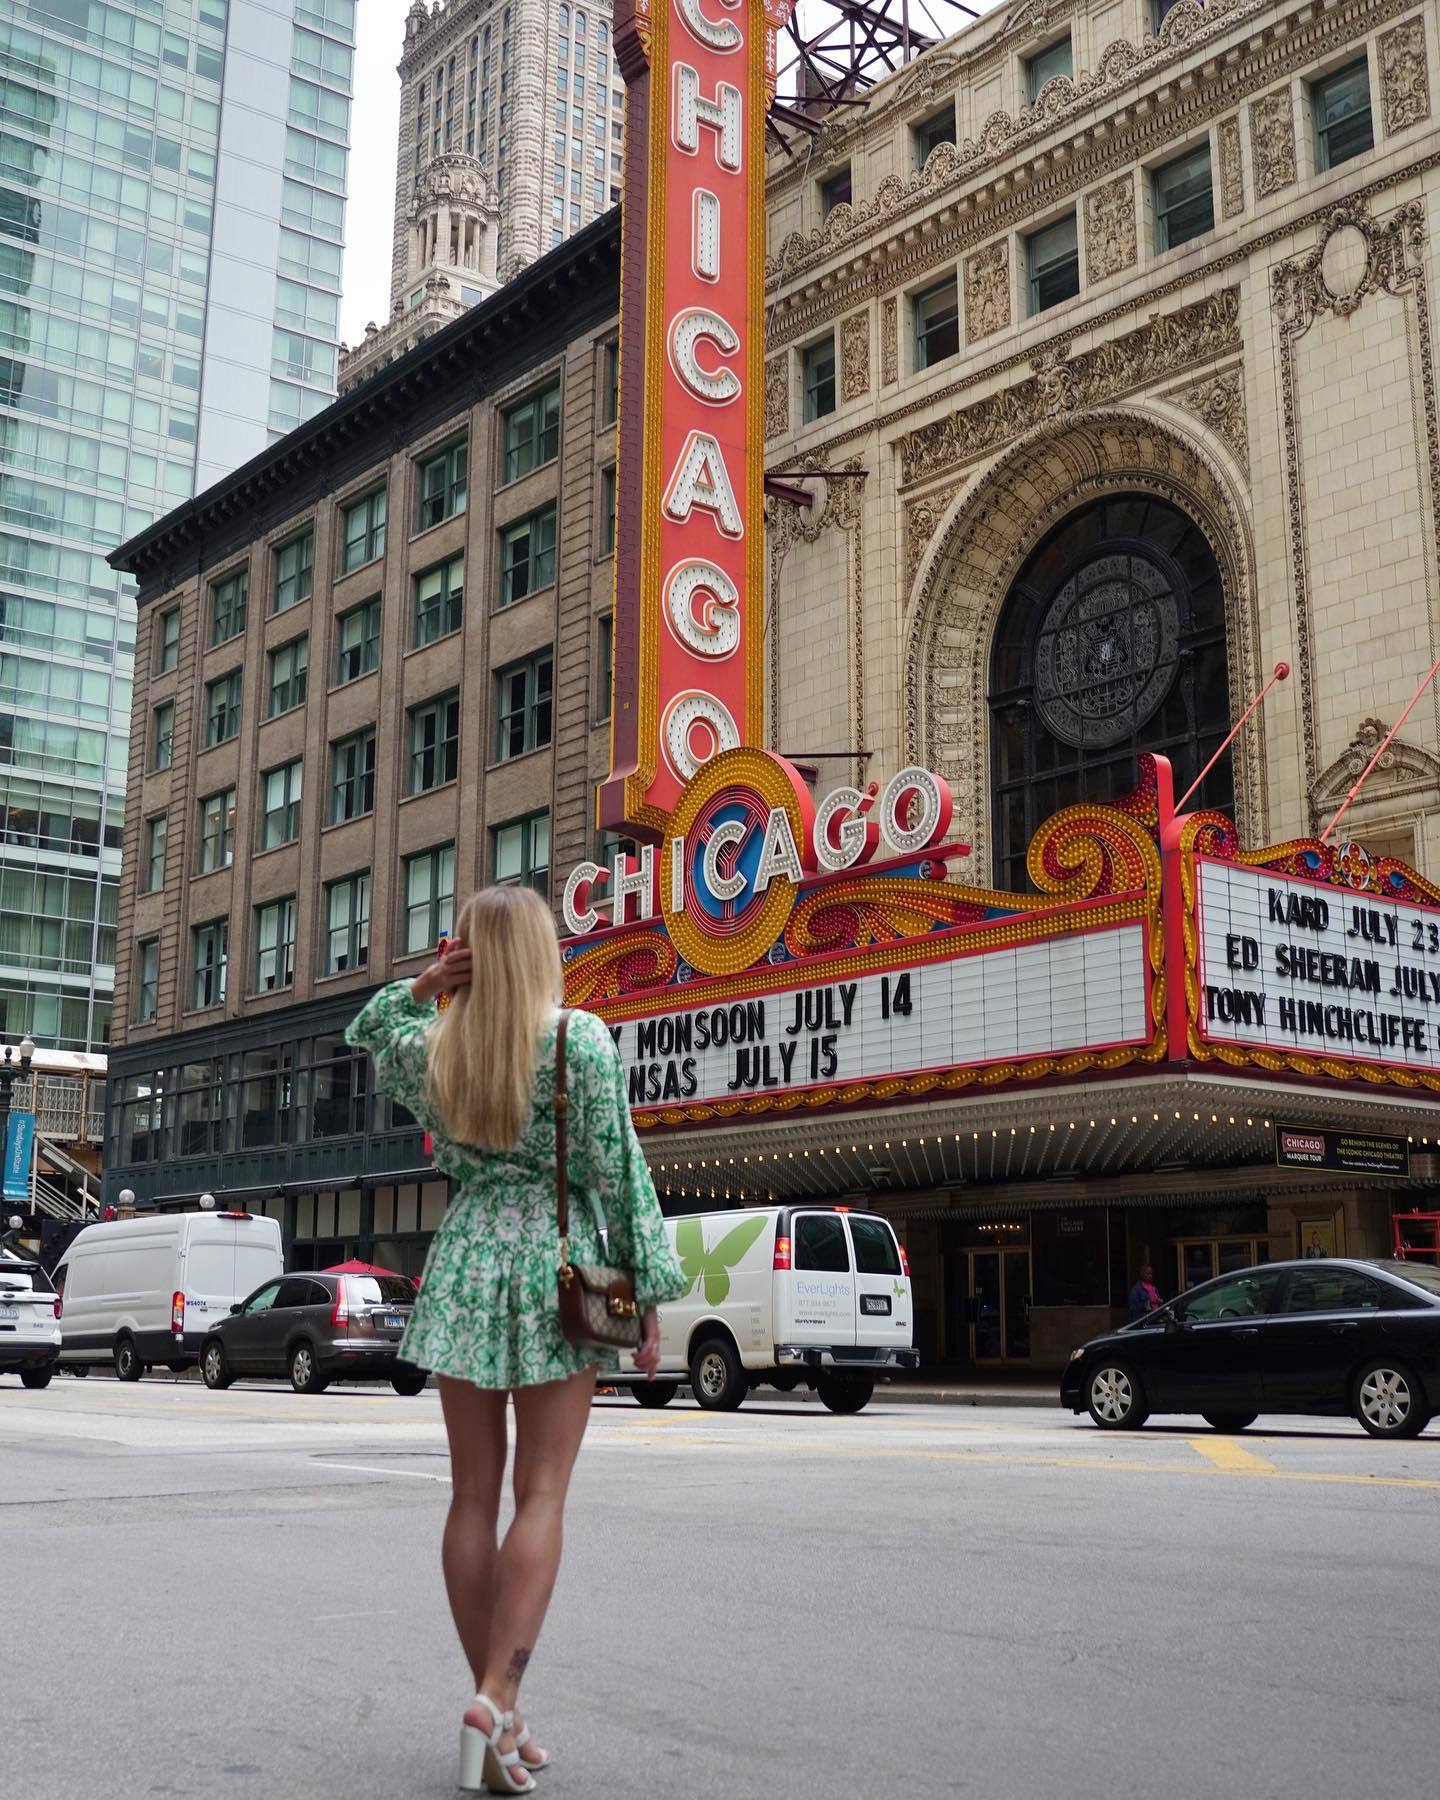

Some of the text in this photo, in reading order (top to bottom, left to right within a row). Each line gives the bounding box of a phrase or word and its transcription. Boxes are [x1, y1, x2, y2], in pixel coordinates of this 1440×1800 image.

[660, 0, 745, 788] CHICAGO
[562, 766, 944, 935] CHICAGO
[1268, 888, 1440, 954] KARD JULY 23
[1226, 933, 1440, 1004] ED SHEERAN JULY
[637, 1000, 765, 1060] MONSOON
[785, 983, 858, 1035] JULY
[881, 973, 912, 1019] 14
[1202, 985, 1267, 1026] TONY
[1279, 996, 1428, 1052] HINCHCLIFFE
[629, 1035, 839, 1104] NSAS JULY 15
[1286, 1138, 1321, 1150] CHICAGO
[1286, 1153, 1322, 1163] MARQUEE TOUR
[797, 1281, 850, 1297] EverLights
